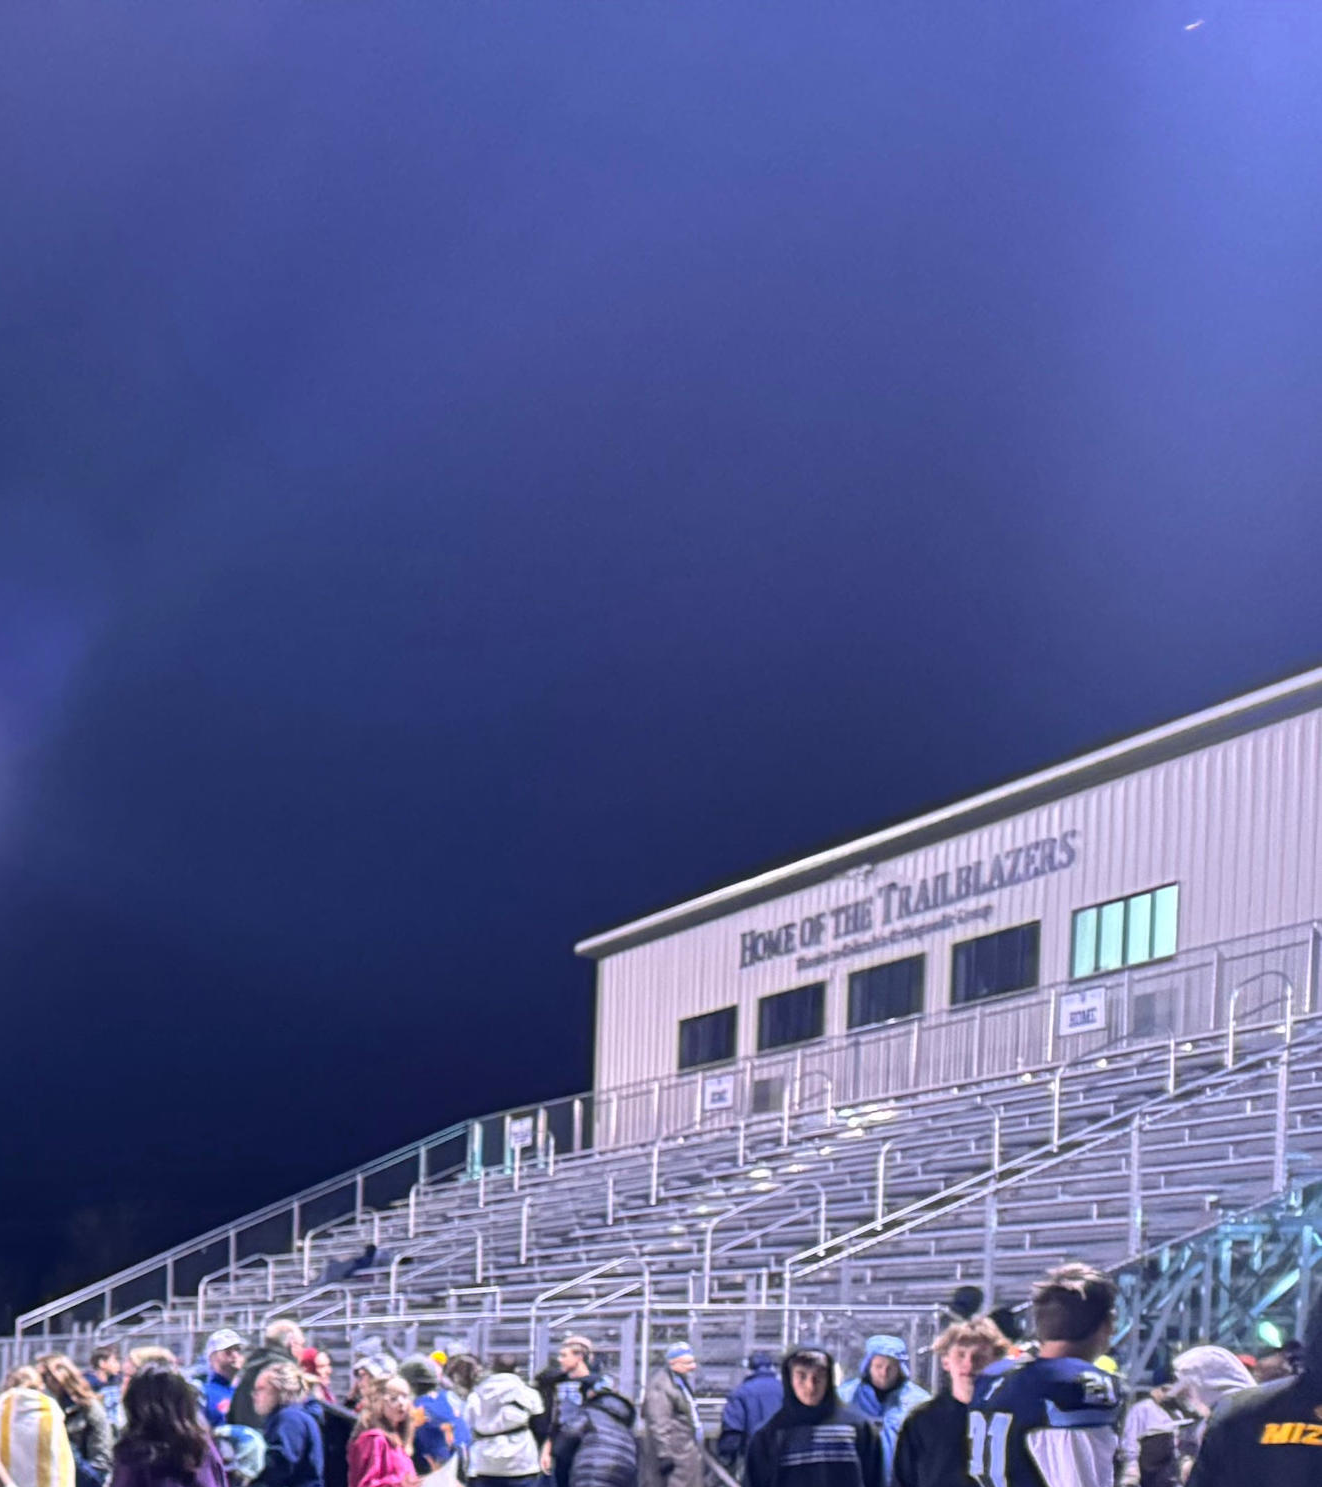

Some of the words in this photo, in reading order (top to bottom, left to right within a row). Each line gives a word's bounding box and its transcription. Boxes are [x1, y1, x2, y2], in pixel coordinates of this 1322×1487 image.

[740, 924, 797, 969] HOME
[800, 913, 828, 949] OF
[830, 898, 872, 940] THE
[877, 830, 1077, 925] TRAILBLAZERS
